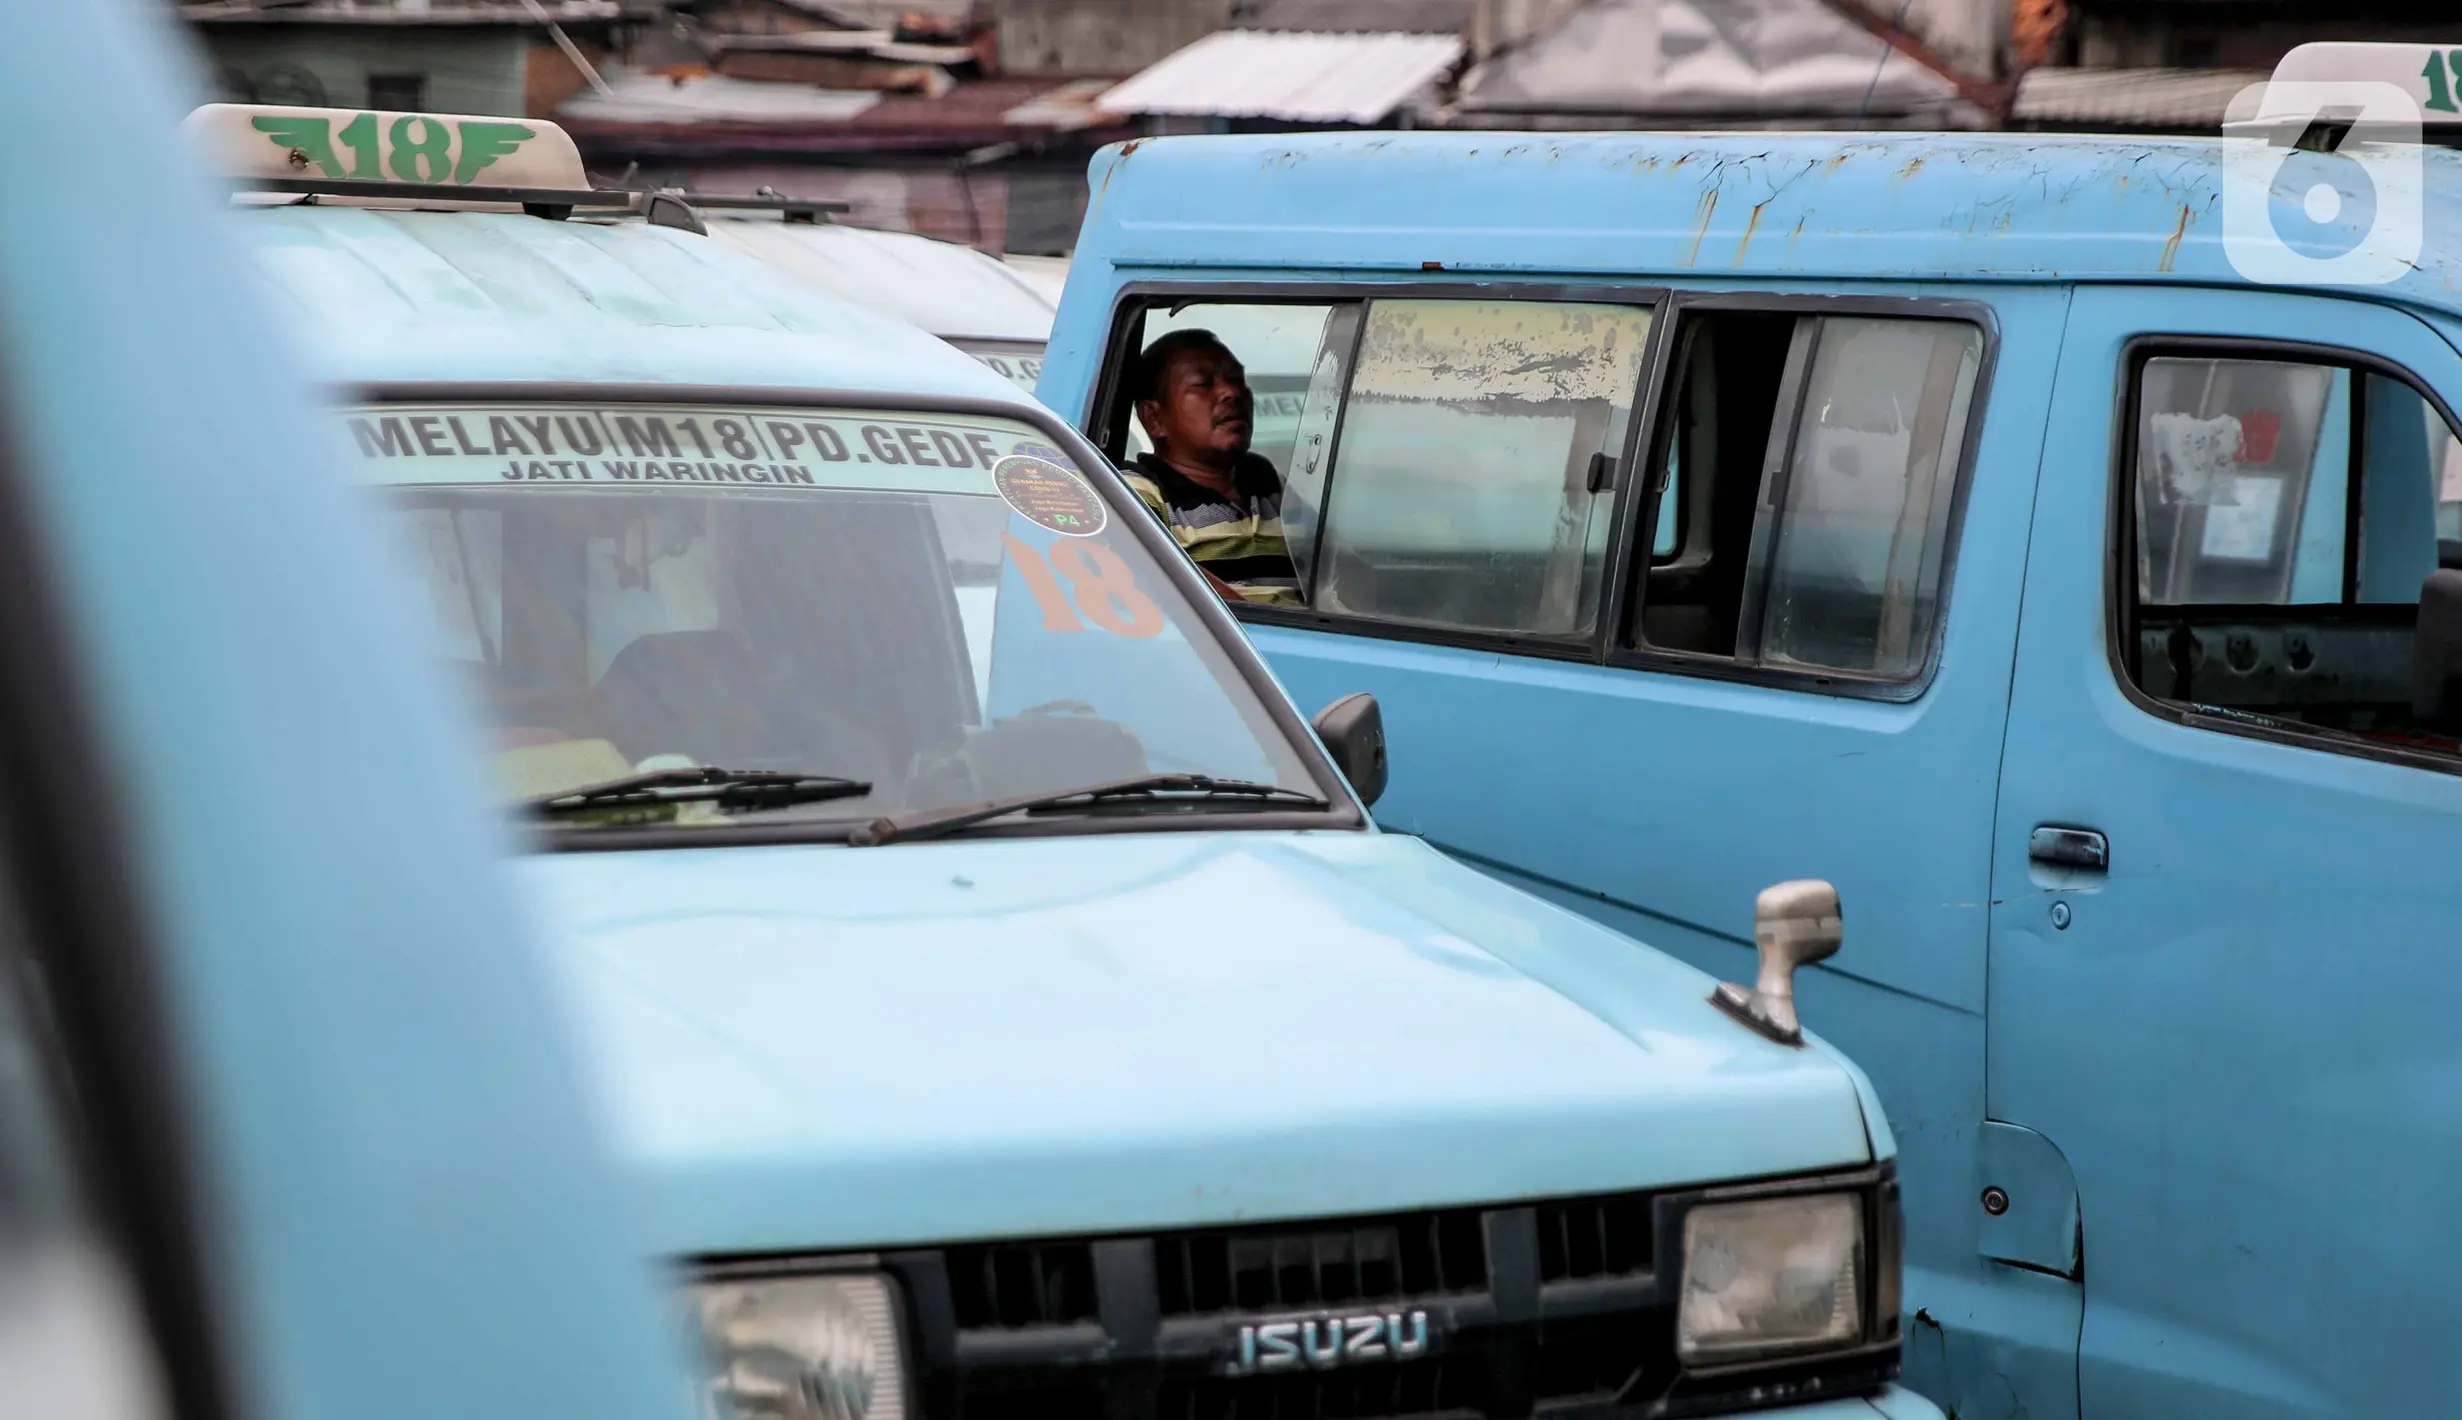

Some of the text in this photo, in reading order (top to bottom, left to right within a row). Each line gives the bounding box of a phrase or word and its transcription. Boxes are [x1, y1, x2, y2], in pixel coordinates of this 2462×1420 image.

[338, 112, 452, 184] 18
[348, 415, 604, 458] MELAYU
[615, 416, 758, 461] M18
[501, 460, 816, 484] JATI WARINGIN
[1054, 513, 1081, 527] P4
[1002, 532, 1164, 638] 18
[1240, 1310, 1428, 1366] ISUZU
